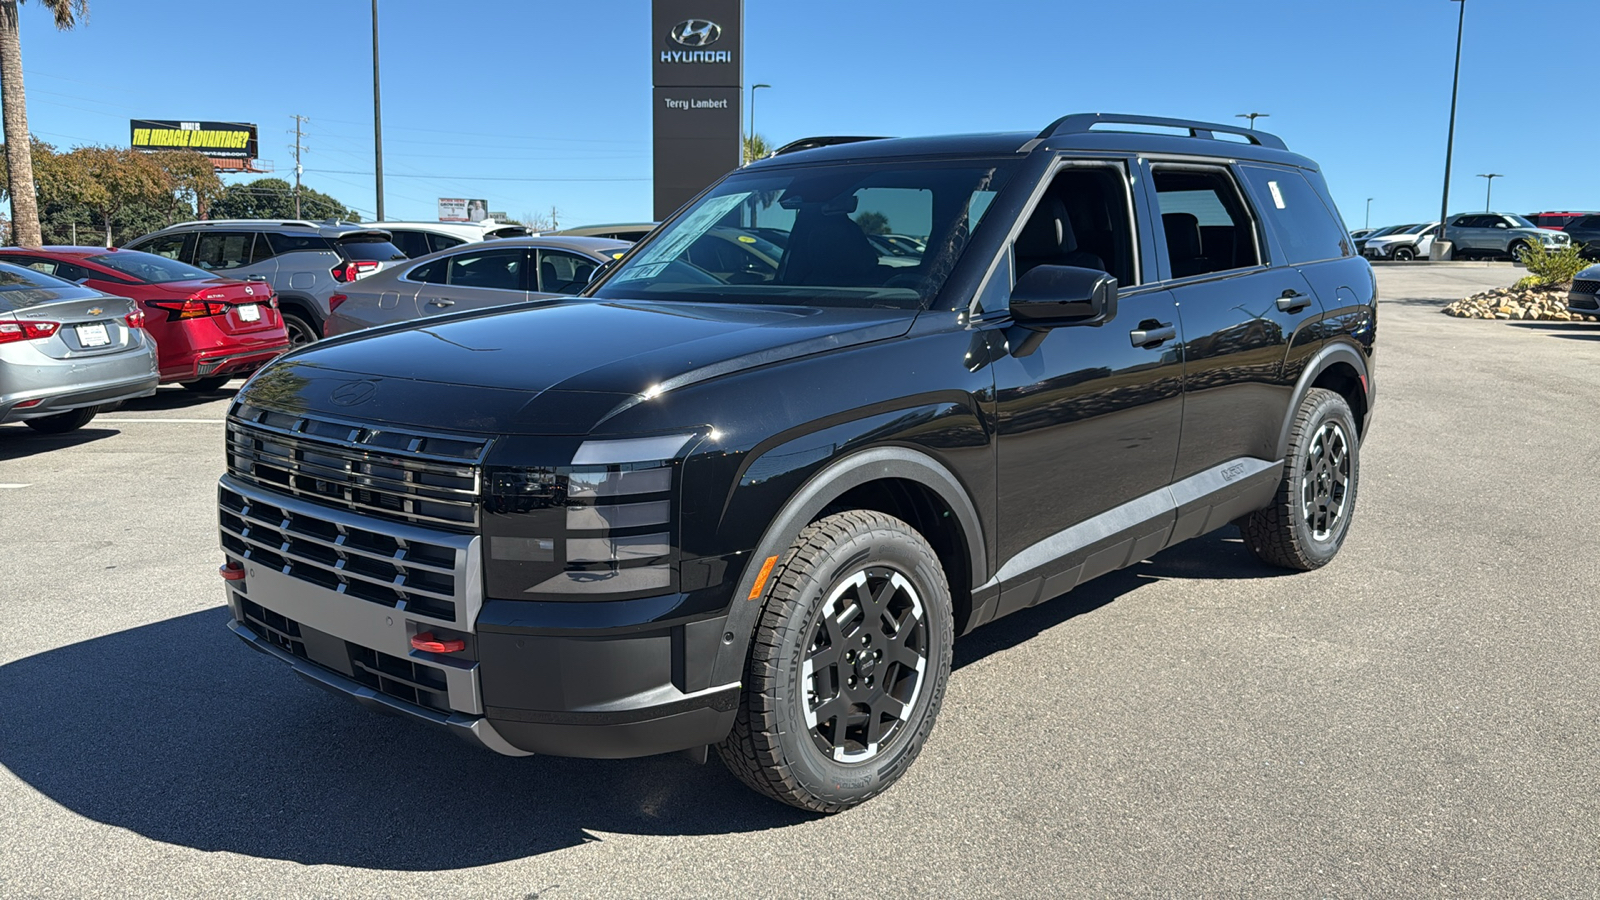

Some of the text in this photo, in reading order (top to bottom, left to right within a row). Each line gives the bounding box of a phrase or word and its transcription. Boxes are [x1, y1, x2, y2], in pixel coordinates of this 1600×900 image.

[660, 50, 731, 63] HYUNDAI
[664, 98, 728, 110] Terry Lambert
[132, 128, 250, 149] THE MIRACLE ADVANTAGE?
